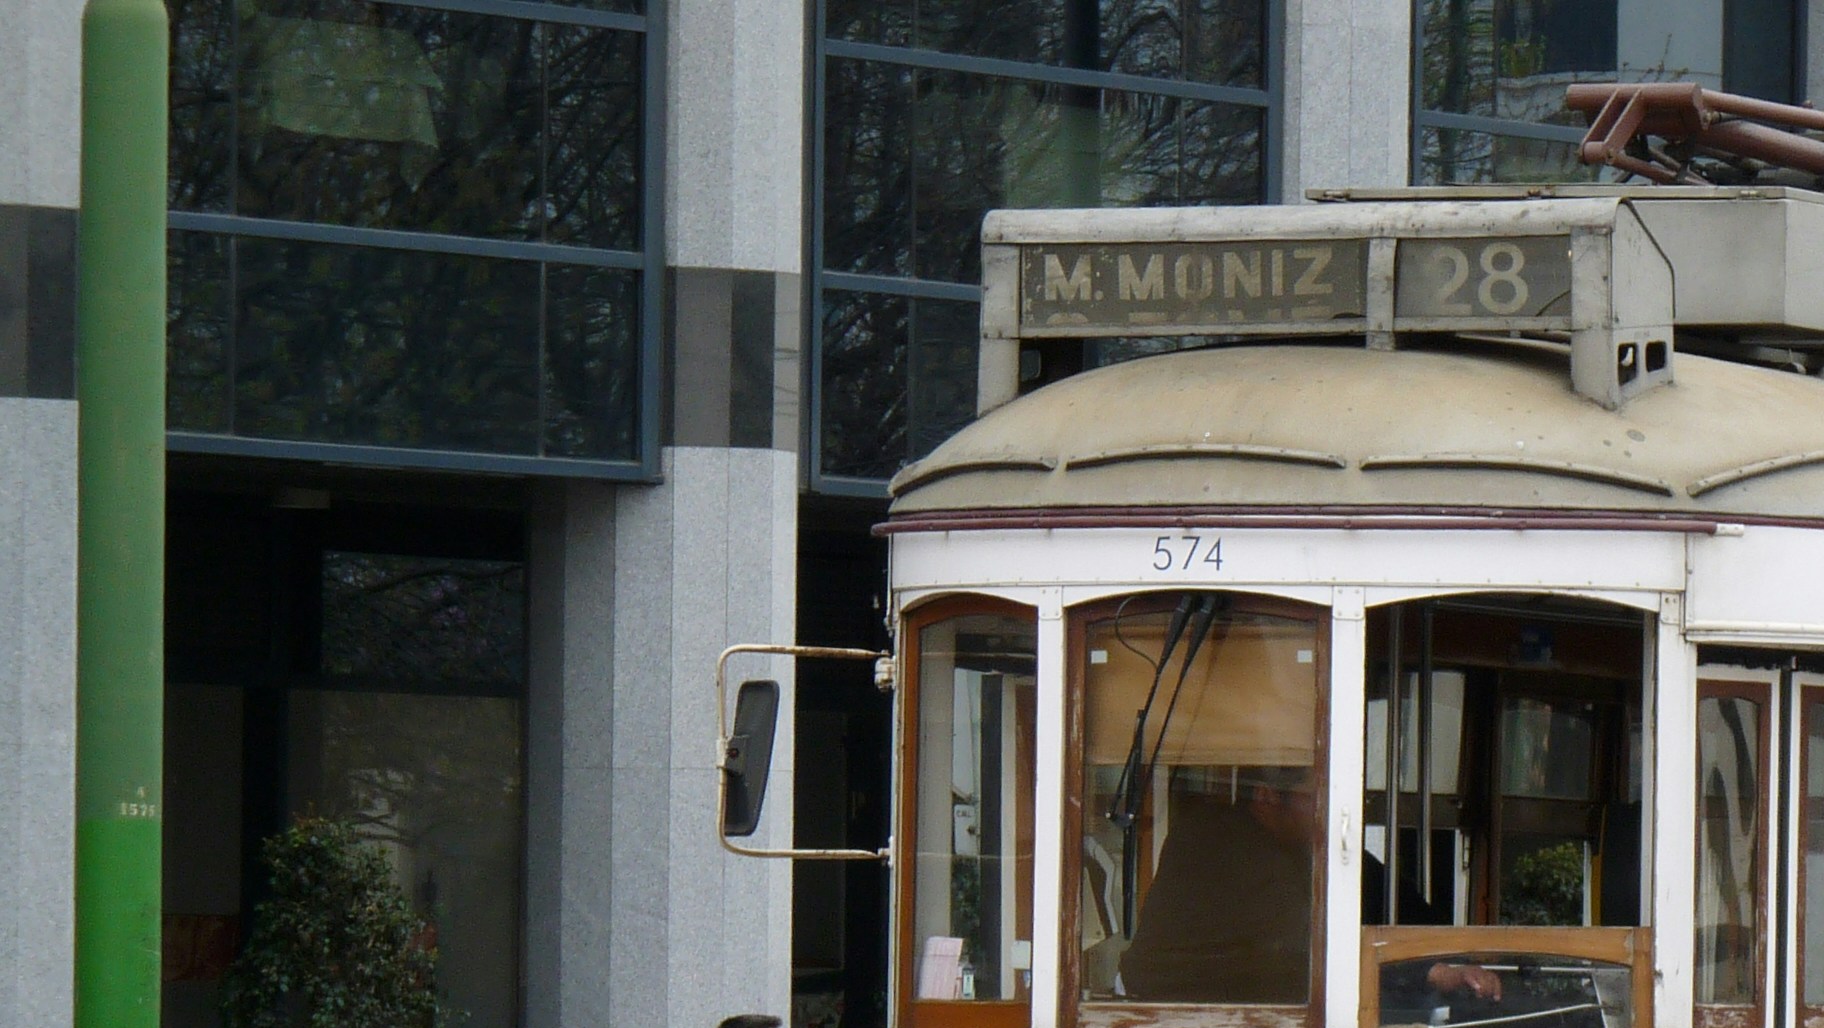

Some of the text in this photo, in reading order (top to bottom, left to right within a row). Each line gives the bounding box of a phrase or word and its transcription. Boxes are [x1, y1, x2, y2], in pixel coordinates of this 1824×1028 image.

[1117, 246, 1335, 301] MONIZ
[1434, 241, 1530, 317] 28
[1152, 535, 1224, 572] 574
